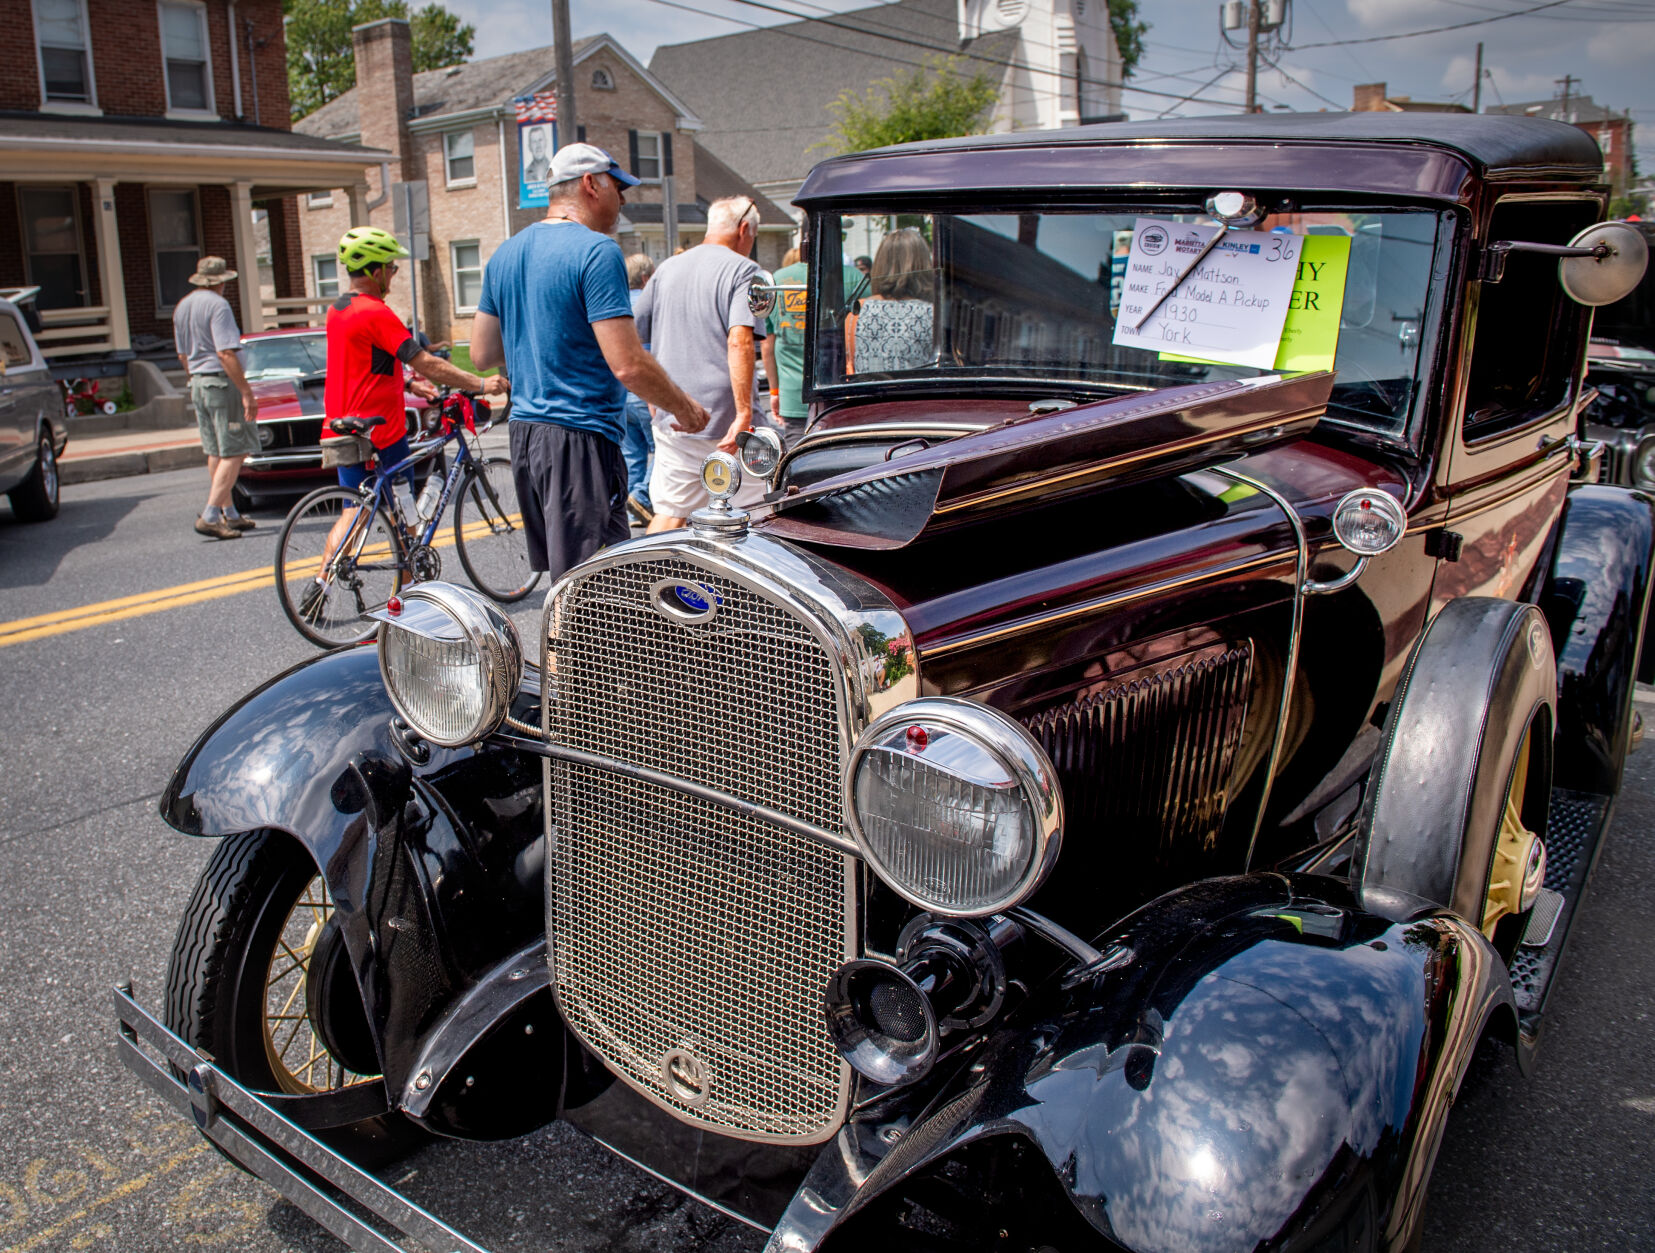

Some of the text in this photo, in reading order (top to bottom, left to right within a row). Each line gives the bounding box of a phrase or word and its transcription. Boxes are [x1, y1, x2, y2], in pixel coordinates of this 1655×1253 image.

[1265, 238, 1294, 262] 36
[1132, 263, 1153, 274] NAME
[1158, 261, 1240, 285] Jay Mattson
[1128, 283, 1149, 294] MAKE
[1185, 284, 1213, 303] Model
[1218, 289, 1227, 304] A
[1234, 289, 1270, 312] Pickup
[1125, 303, 1143, 314] YEAR
[1163, 302, 1198, 322] 1930
[1121, 325, 1141, 336] TOWN
[1158, 322, 1192, 345] York
